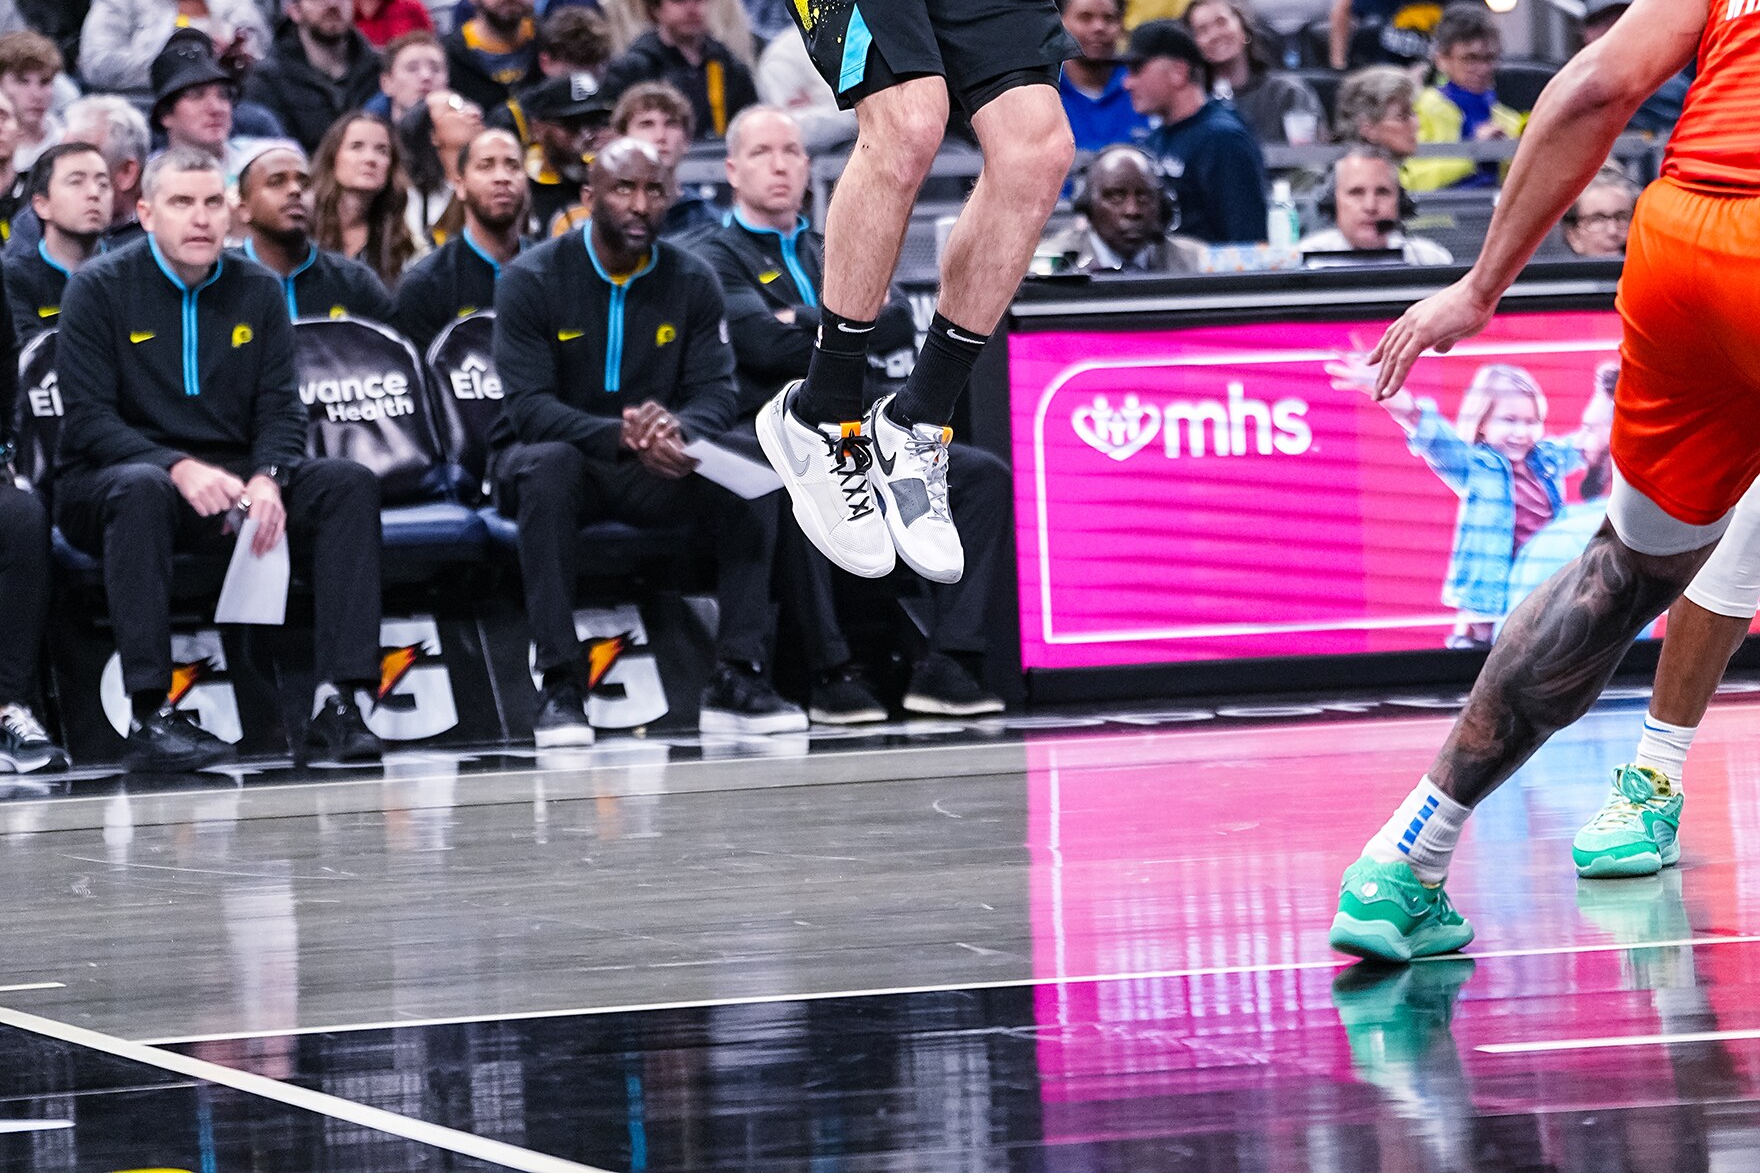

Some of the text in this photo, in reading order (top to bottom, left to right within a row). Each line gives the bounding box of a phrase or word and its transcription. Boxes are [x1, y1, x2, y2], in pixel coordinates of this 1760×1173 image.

[299, 371, 408, 405] vance
[325, 395, 415, 422] Health
[1163, 381, 1313, 459] mhs
